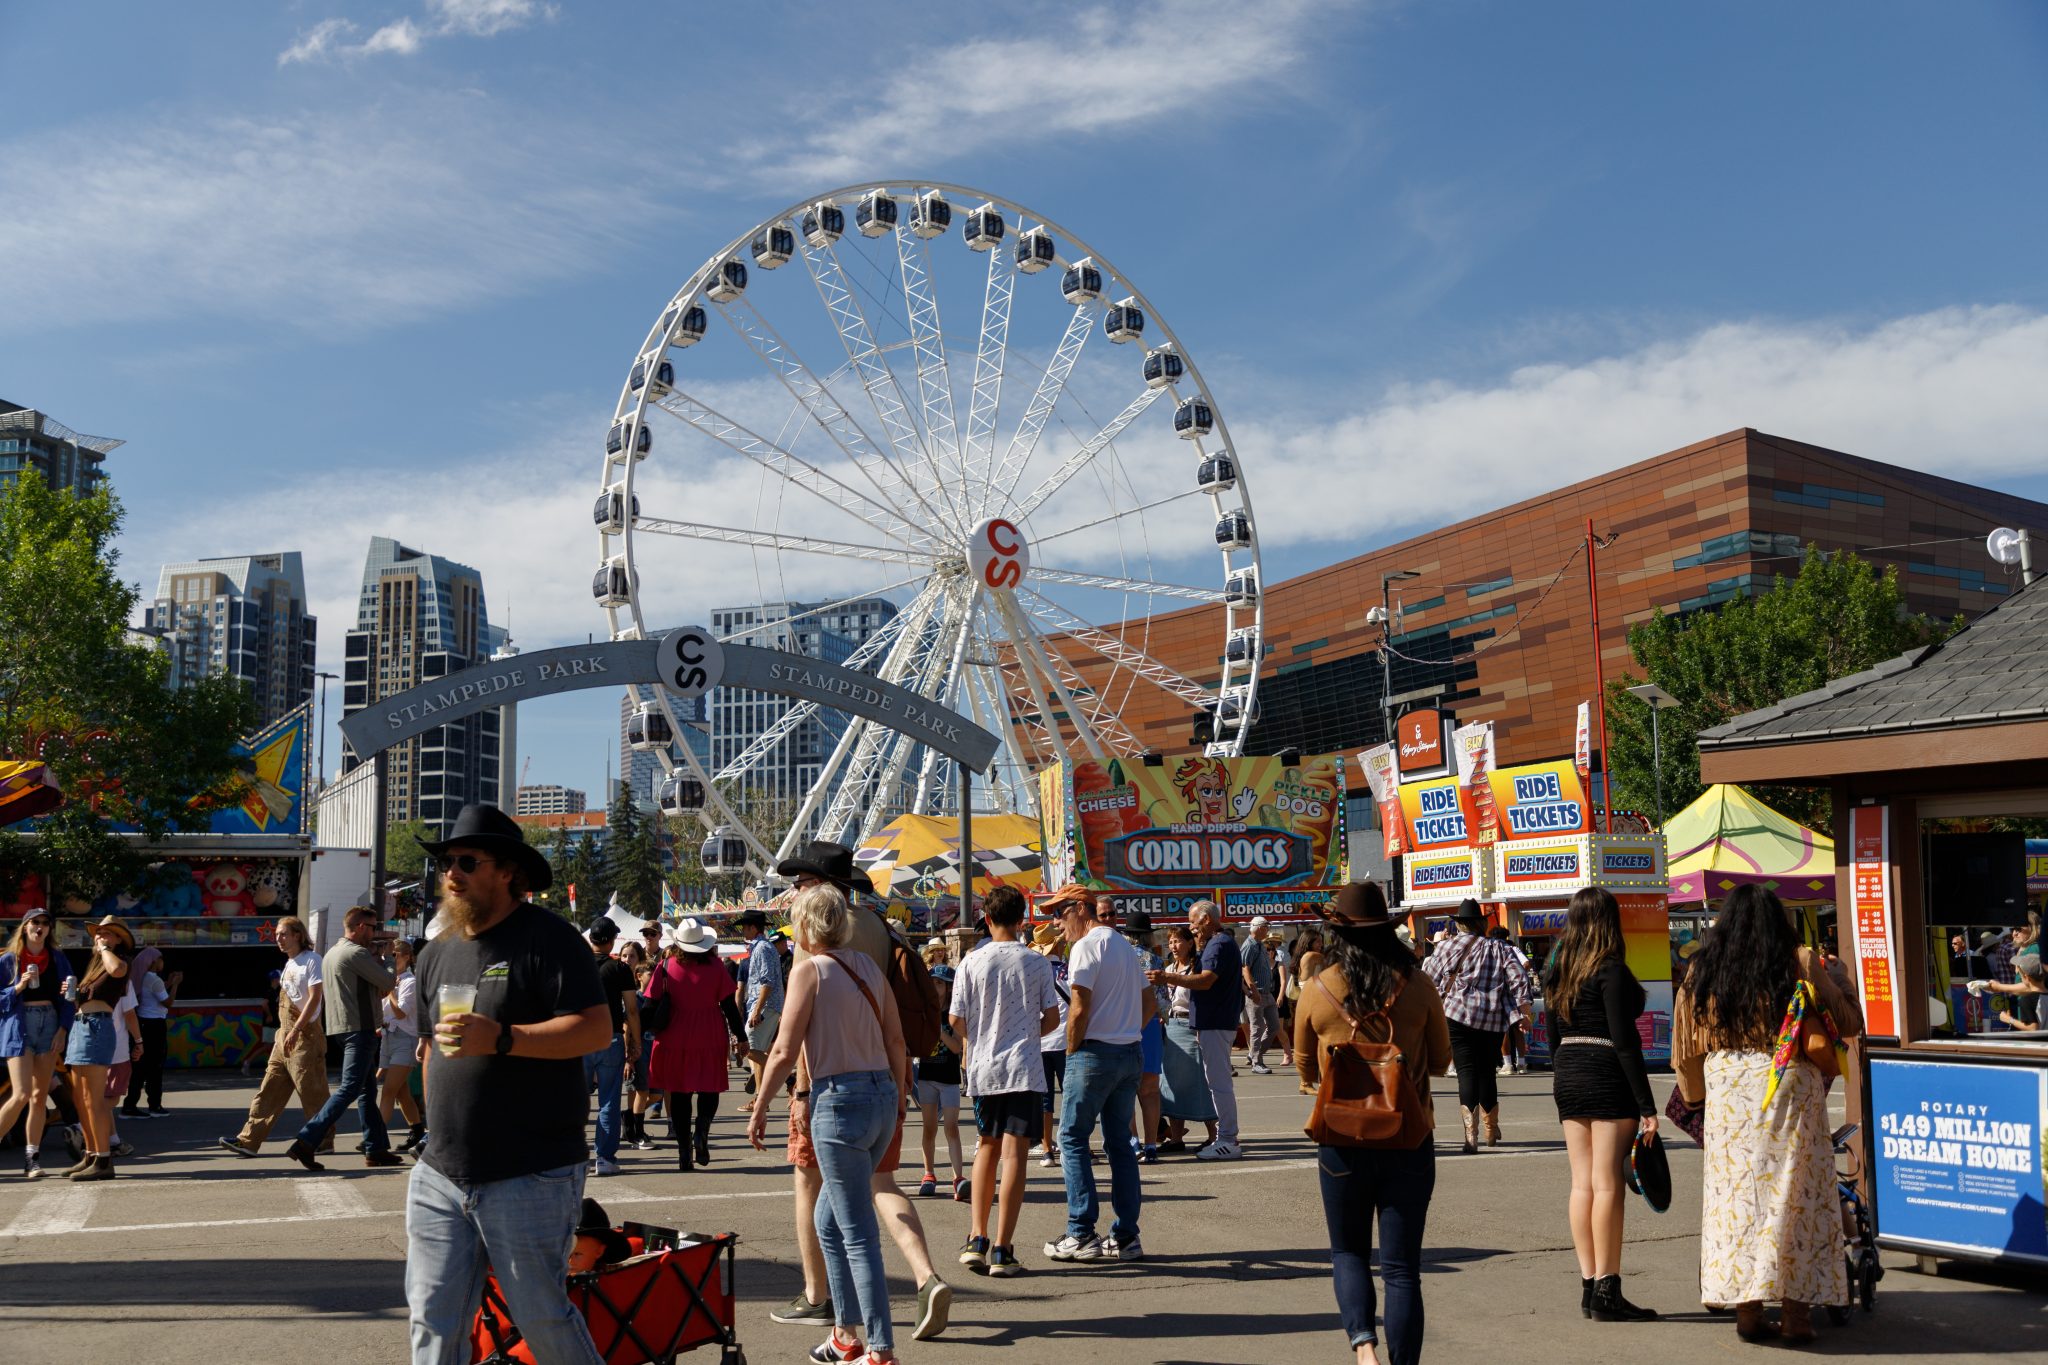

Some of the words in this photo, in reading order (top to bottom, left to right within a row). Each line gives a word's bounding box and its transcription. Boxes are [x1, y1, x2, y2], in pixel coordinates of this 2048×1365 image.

[387, 670, 526, 729] STAMPEDE
[537, 656, 608, 681] PARK
[769, 663, 893, 711] STAMPEDE
[903, 704, 961, 743] PARK
[1465, 734, 1486, 752] BUY
[1371, 752, 1390, 770] BUY
[1273, 780, 1331, 803] PICKLE
[1515, 775, 1558, 799] RIDE
[1078, 795, 1137, 813] CHEESE
[1275, 793, 1322, 817] DOG
[1420, 788, 1456, 812] RIDE
[1510, 803, 1579, 829] TICKETS
[1170, 823, 1203, 833] HAND
[1207, 822, 1247, 833] DIPPED
[1415, 815, 1467, 840] TICKET
[1128, 839, 1202, 871] CORN
[1209, 837, 1289, 870] DOGS
[1509, 857, 1533, 872] RIDE
[1535, 854, 1578, 871] TICKETS
[1604, 855, 1651, 867] TICKETS
[1415, 867, 1435, 883] RIDE
[1437, 863, 1470, 880] TICKETS
[1113, 897, 1162, 914] CKLE
[1167, 897, 1208, 913] DO
[1227, 892, 1331, 905] MEATZA-MOZZA
[1227, 903, 1293, 915] CORNDOG
[1523, 913, 1546, 929] RIDE
[1861, 948, 1888, 959] 50/50
[1921, 1101, 1988, 1116] ROTARY
[1881, 1113, 1930, 1138] $1.49
[1934, 1117, 2031, 1148] MILLION
[1883, 1137, 1962, 1166] DREAM
[1966, 1144, 2032, 1174] HOME
